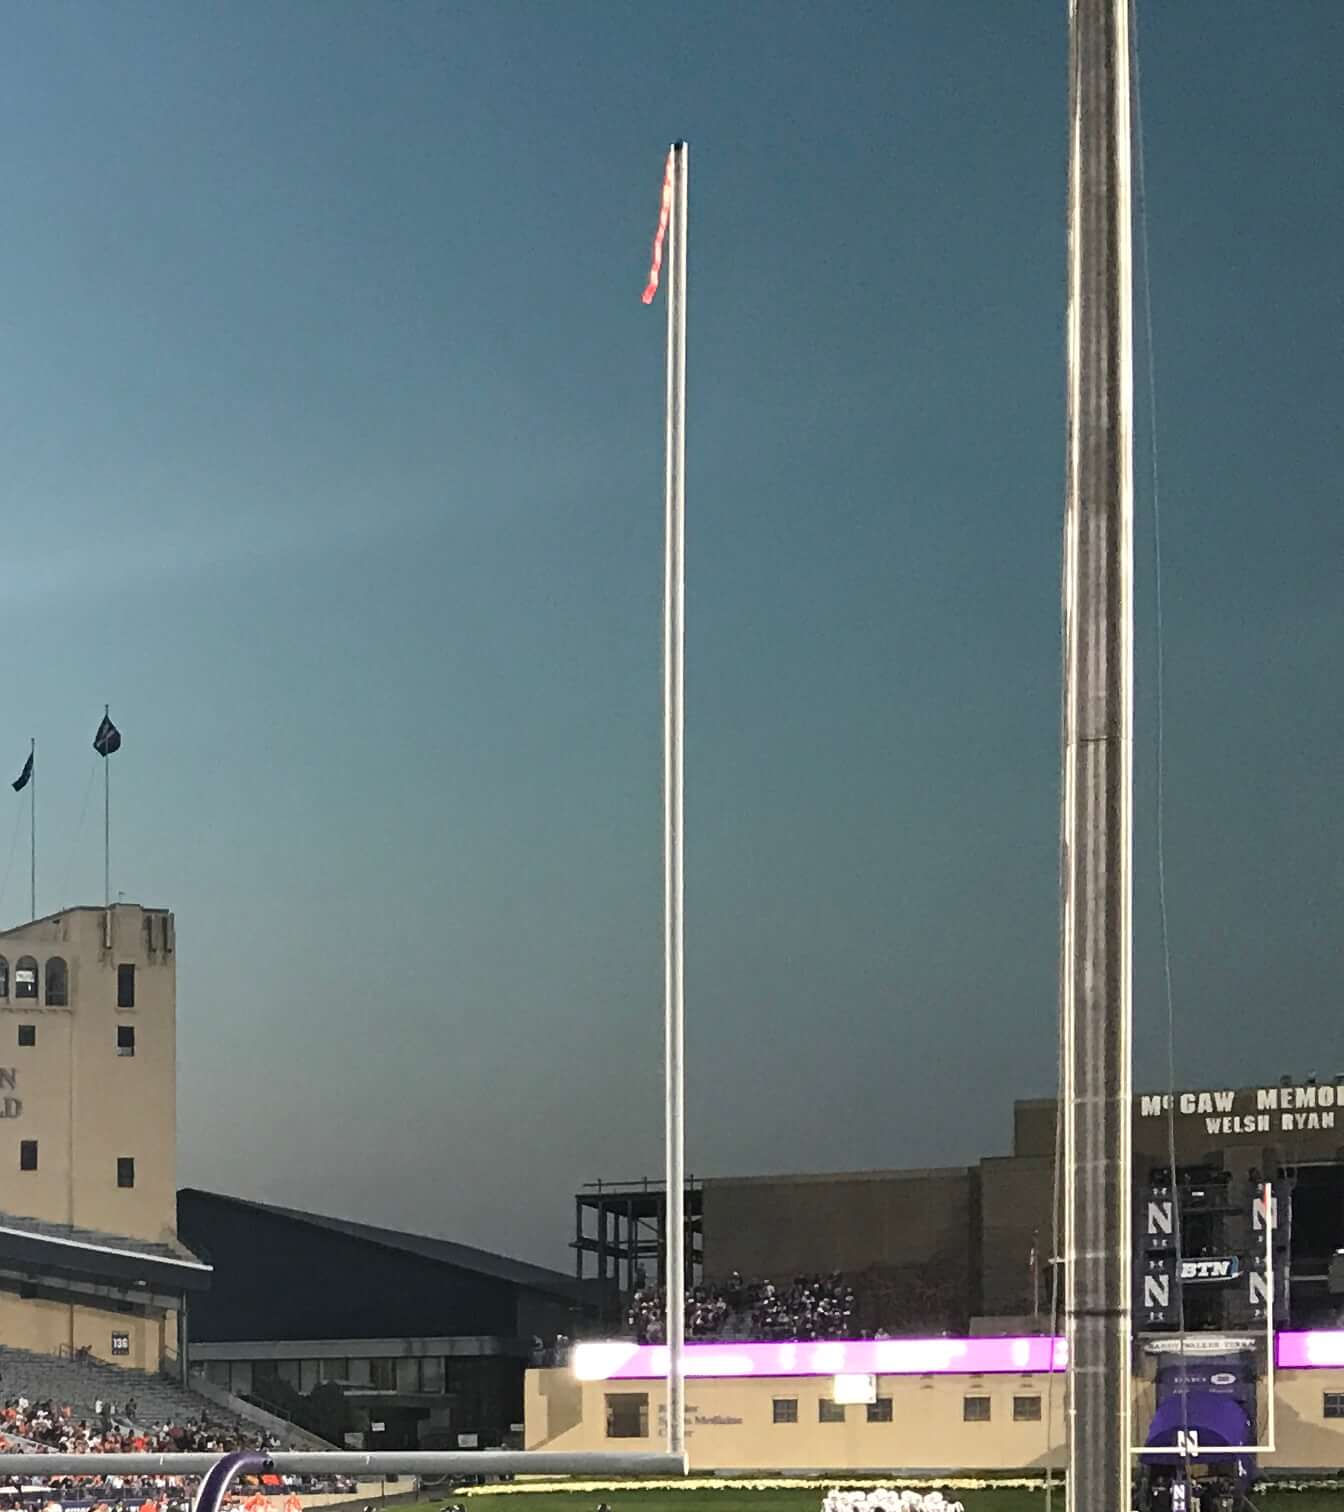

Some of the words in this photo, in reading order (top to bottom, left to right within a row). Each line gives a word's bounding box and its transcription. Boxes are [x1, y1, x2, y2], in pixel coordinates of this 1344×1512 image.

[1205, 1115, 1271, 1135] WELSH
[1282, 1111, 1335, 1131] RYAN
[1147, 1201, 1173, 1234] N
[1180, 1260, 1231, 1278] BTN
[1143, 1273, 1169, 1307] N
[1177, 1430, 1199, 1456] N
